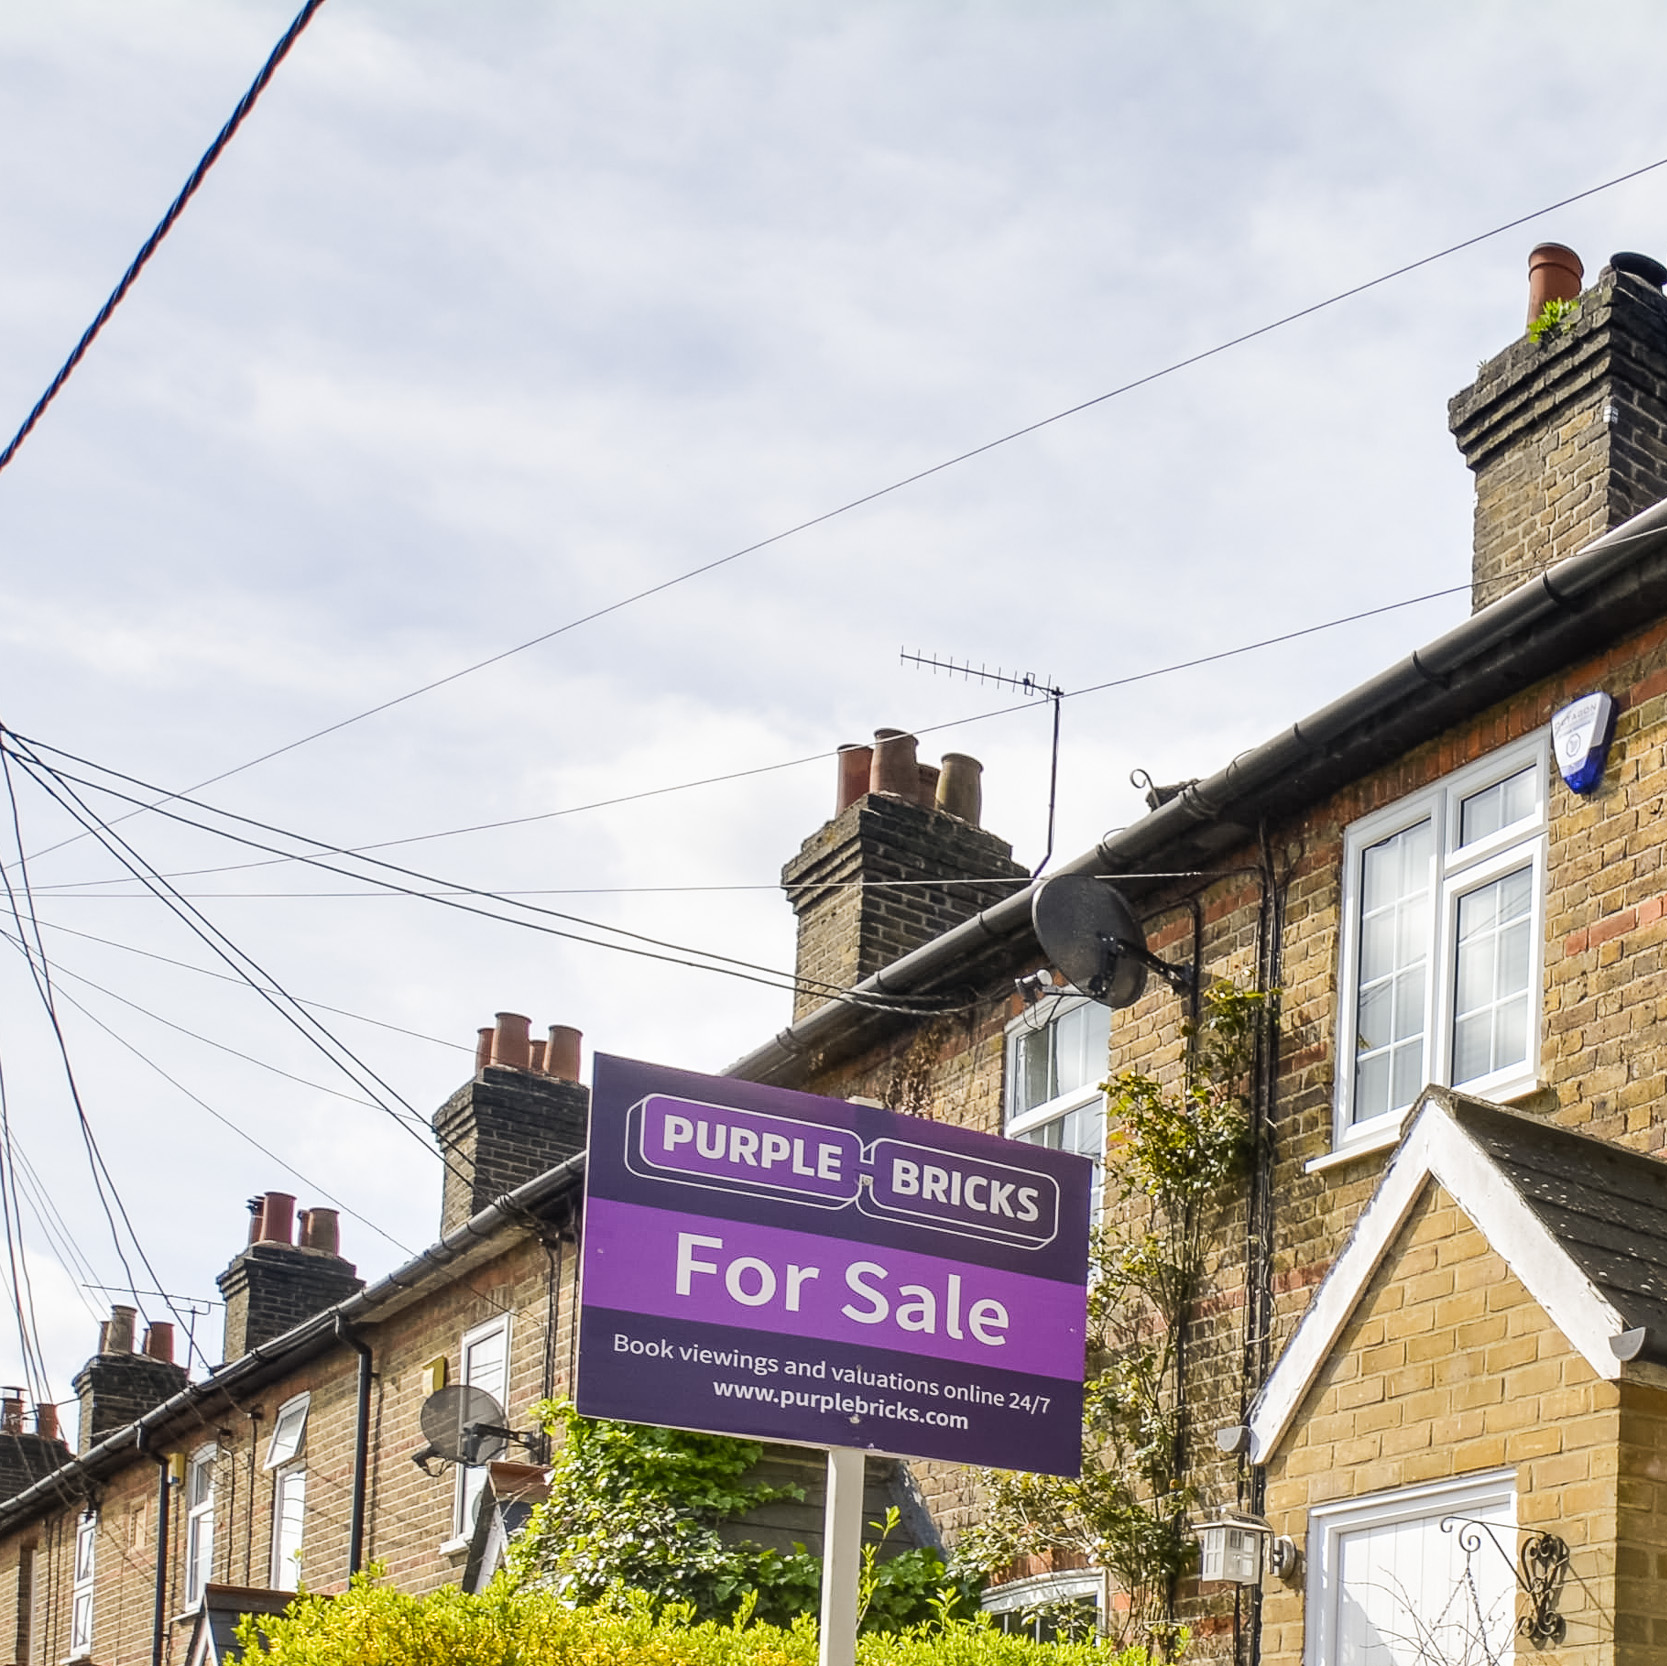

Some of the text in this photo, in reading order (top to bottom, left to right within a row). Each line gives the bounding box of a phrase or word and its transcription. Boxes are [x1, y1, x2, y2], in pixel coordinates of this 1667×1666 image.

[663, 1114, 1039, 1222] PURPLE BRICKS
[674, 1232, 1010, 1346] For Sale
[614, 1333, 1051, 1415] Book viewings and valuations online 24/7
[713, 1381, 969, 1429] www.purplebricks.com
